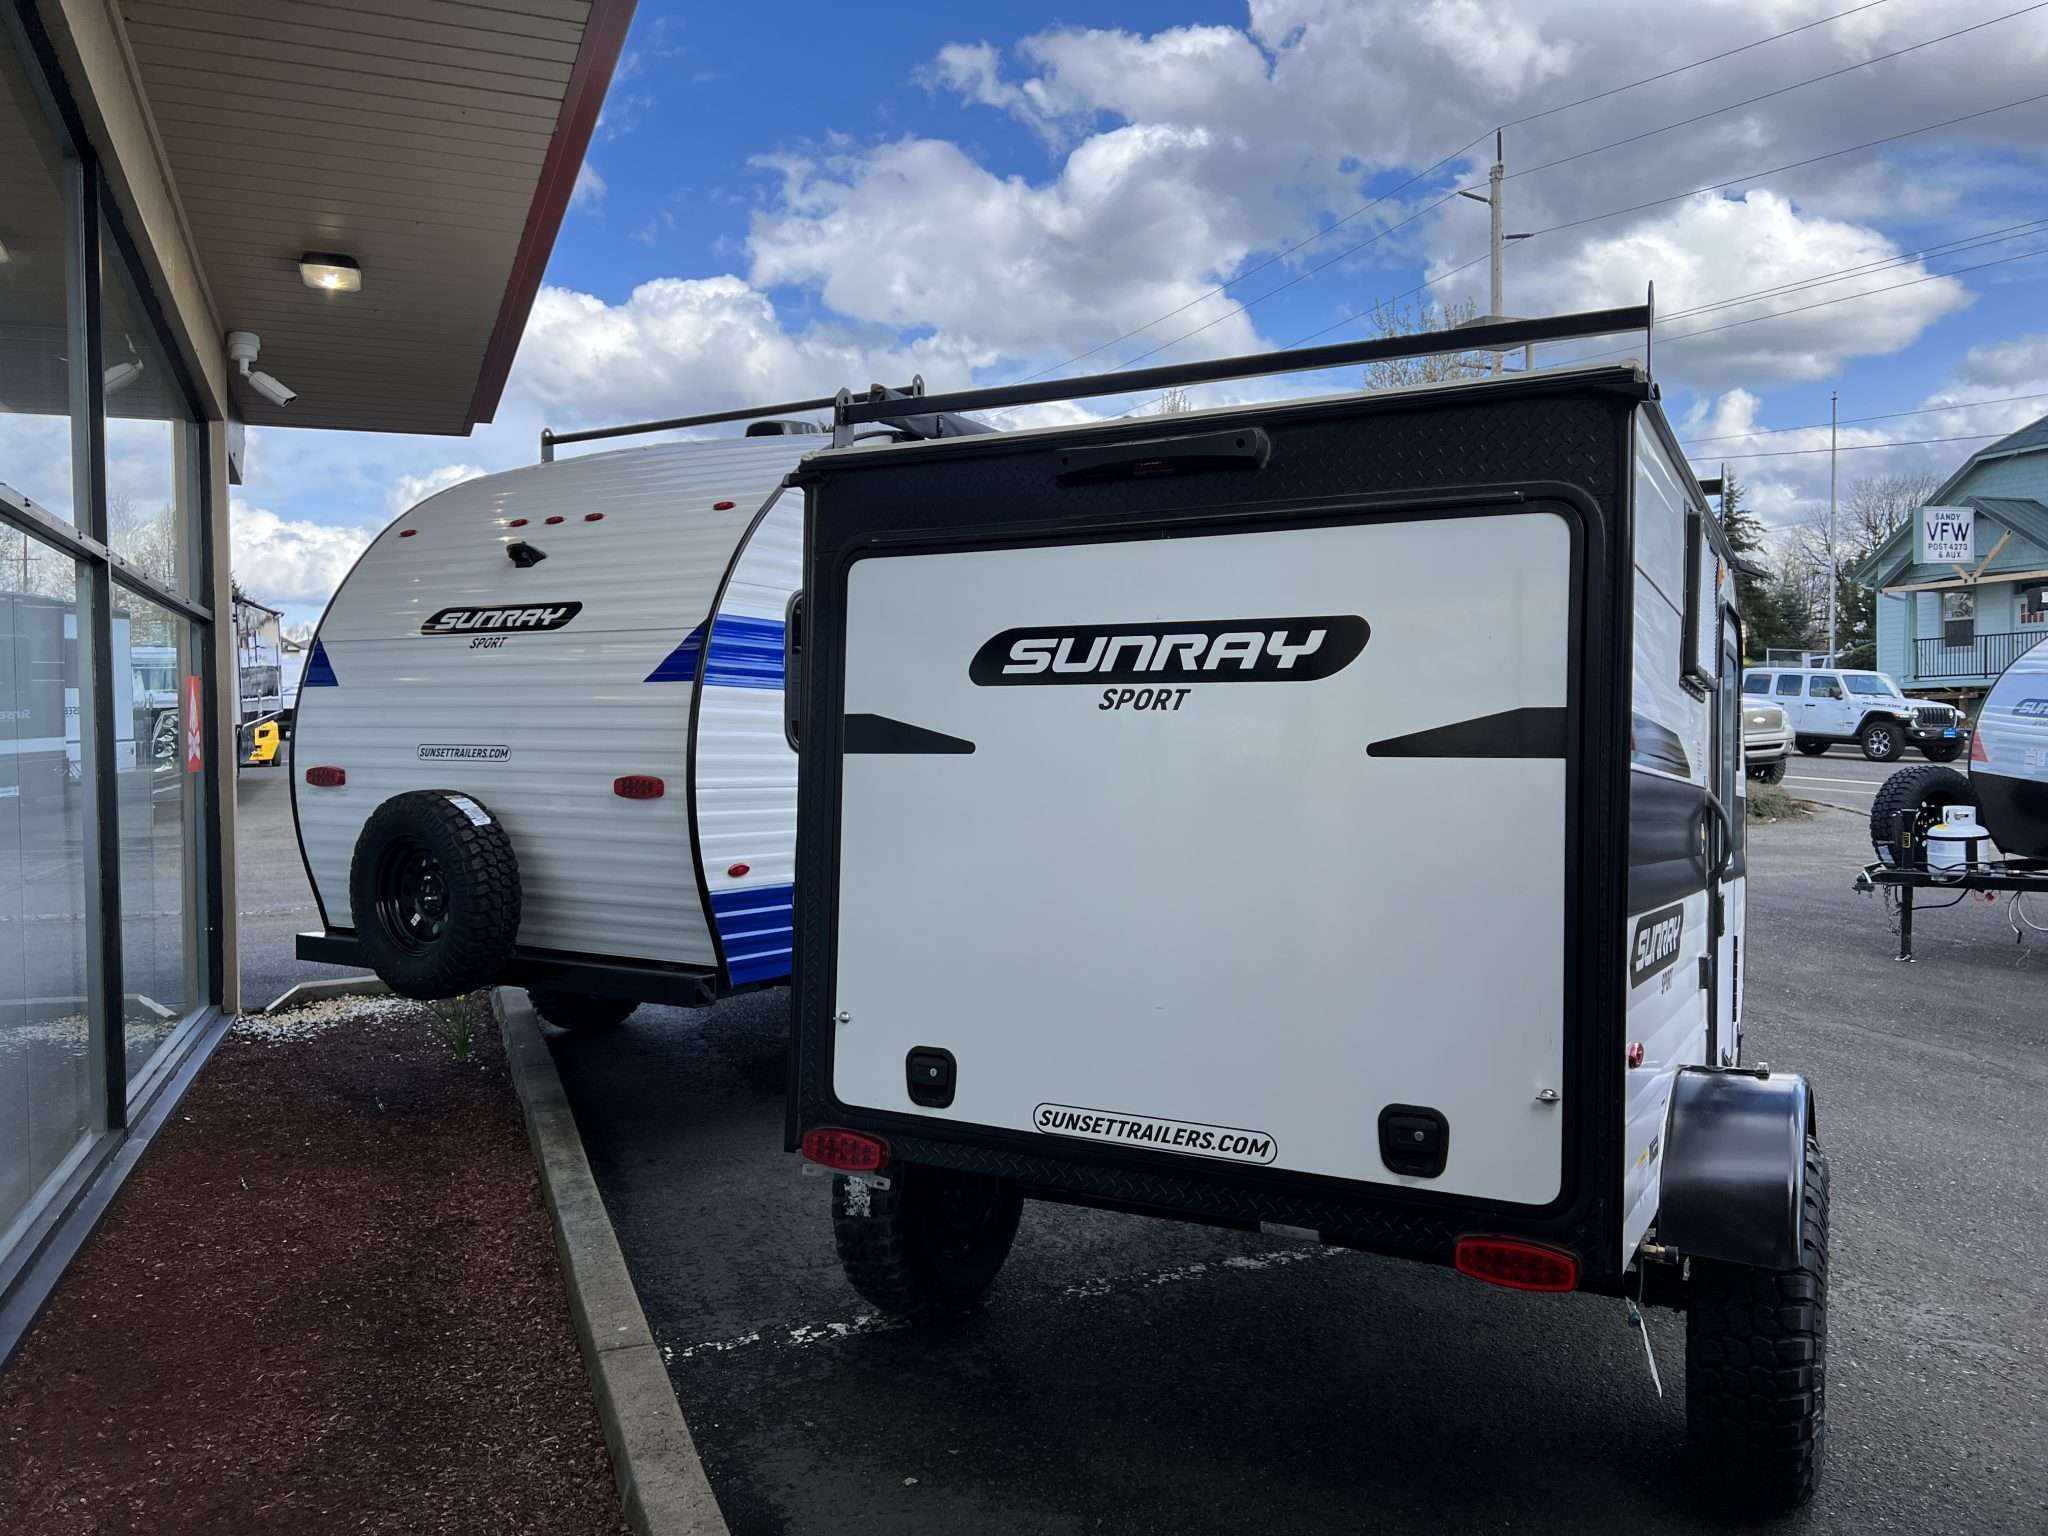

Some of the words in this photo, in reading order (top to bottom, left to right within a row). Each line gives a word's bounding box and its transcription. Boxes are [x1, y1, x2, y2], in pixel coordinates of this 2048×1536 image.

[1935, 512, 1961, 521] SANDY
[1926, 521, 1970, 541] VFW
[1928, 543, 1948, 551] POST
[1949, 543, 1968, 551] 4273
[1946, 551, 1961, 559] AUX
[434, 608, 568, 630] SUNRAY
[469, 637, 508, 649] SPORT
[1001, 629, 1328, 675] SUNRAY
[1098, 687, 1191, 711] SPORT
[419, 747, 509, 759] SUNSETTRAILERS.COM
[1635, 914, 1681, 973] SUNRAY
[1038, 1109, 1271, 1158] SUNSETTRAILERS.COM
